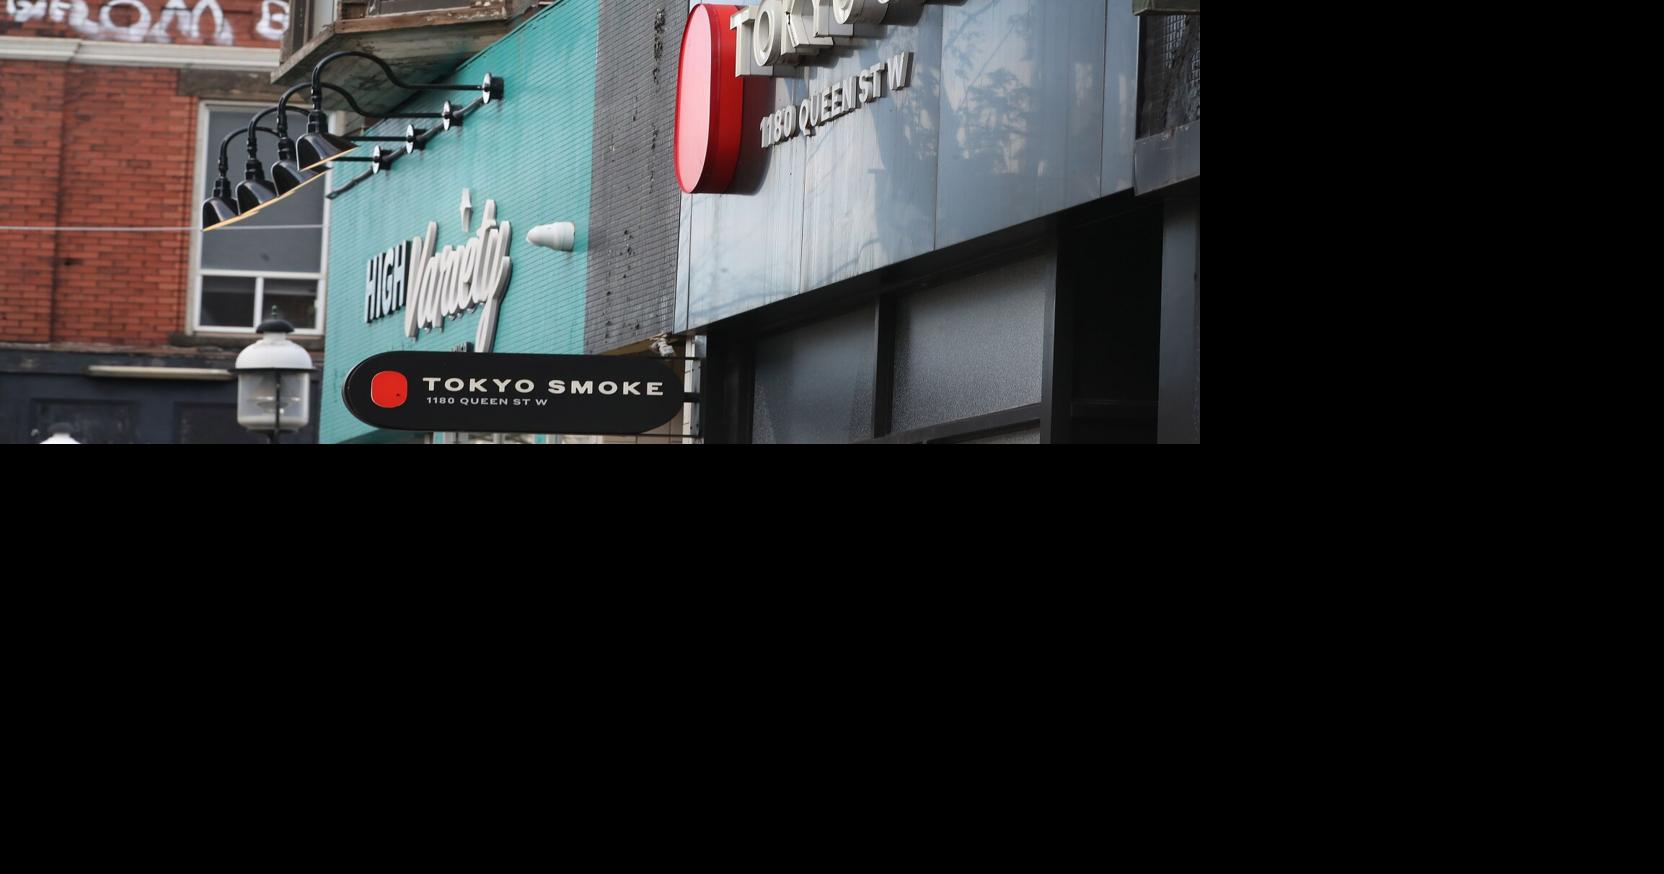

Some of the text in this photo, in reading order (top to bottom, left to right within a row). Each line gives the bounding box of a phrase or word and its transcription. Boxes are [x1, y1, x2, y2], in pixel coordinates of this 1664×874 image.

[759, 51, 912, 149] 1180 QUEEN ST W
[364, 190, 512, 352] HIGH Variety
[422, 377, 664, 396] TOKYO SMOKE
[426, 397, 548, 406] 1180 QUEEN ST W
